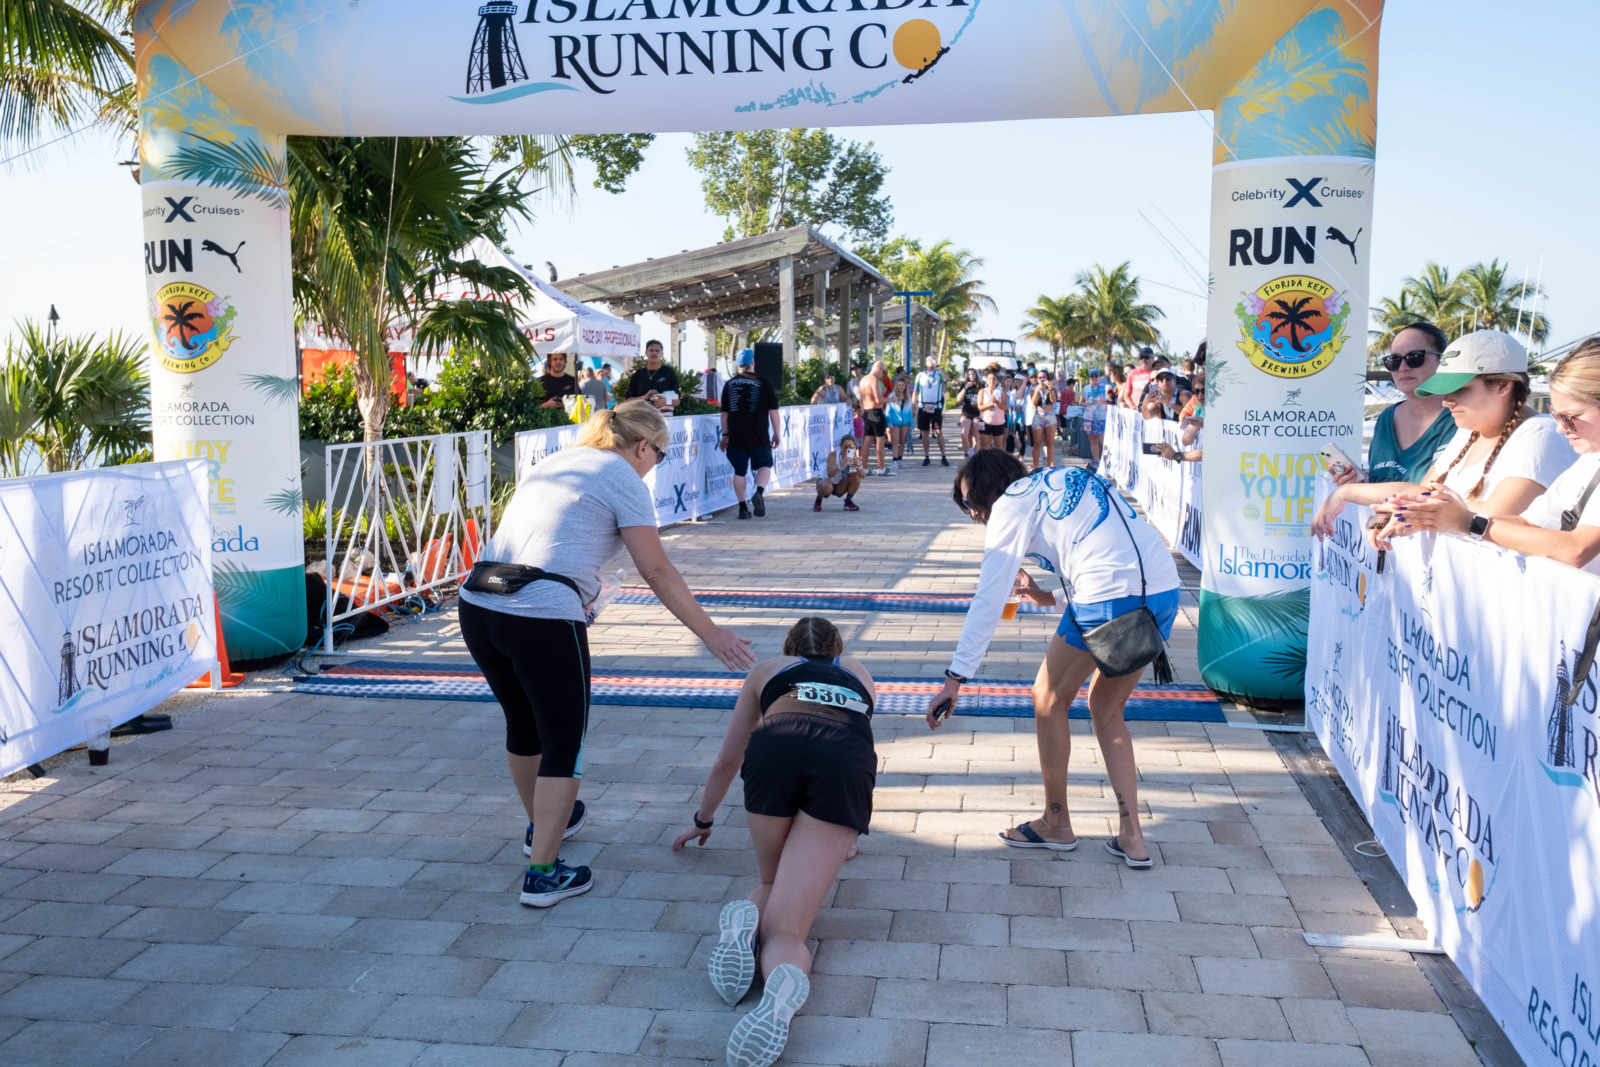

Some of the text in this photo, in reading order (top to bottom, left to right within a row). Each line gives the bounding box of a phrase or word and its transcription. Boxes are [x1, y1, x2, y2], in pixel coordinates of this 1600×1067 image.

[548, 25, 834, 94] RUNNING
[1232, 188, 1286, 202] Celebrity
[1321, 186, 1362, 199] Cruises
[192, 204, 240, 216] Cruises
[1229, 226, 1316, 266] RUN
[144, 238, 193, 275] RUN
[159, 285, 210, 301] FLORIDA KEYS
[1263, 279, 1330, 296] FLORIDA KEYS
[163, 357, 196, 371] BREWING
[1261, 359, 1307, 375] BREWING
[176, 414, 255, 426] COLLECTION
[1244, 410, 1336, 422] ISLAMORADA
[1222, 424, 1354, 437] RESORT COLLECTION
[212, 525, 239, 540] Keys
[83, 530, 178, 566] ISLAMORADA
[1239, 547, 1260, 561] The
[1262, 548, 1306, 562] Florida
[54, 568, 113, 605] RESORT
[76, 592, 204, 657] ISLAMORADA
[87, 633, 174, 691] RUNNING
